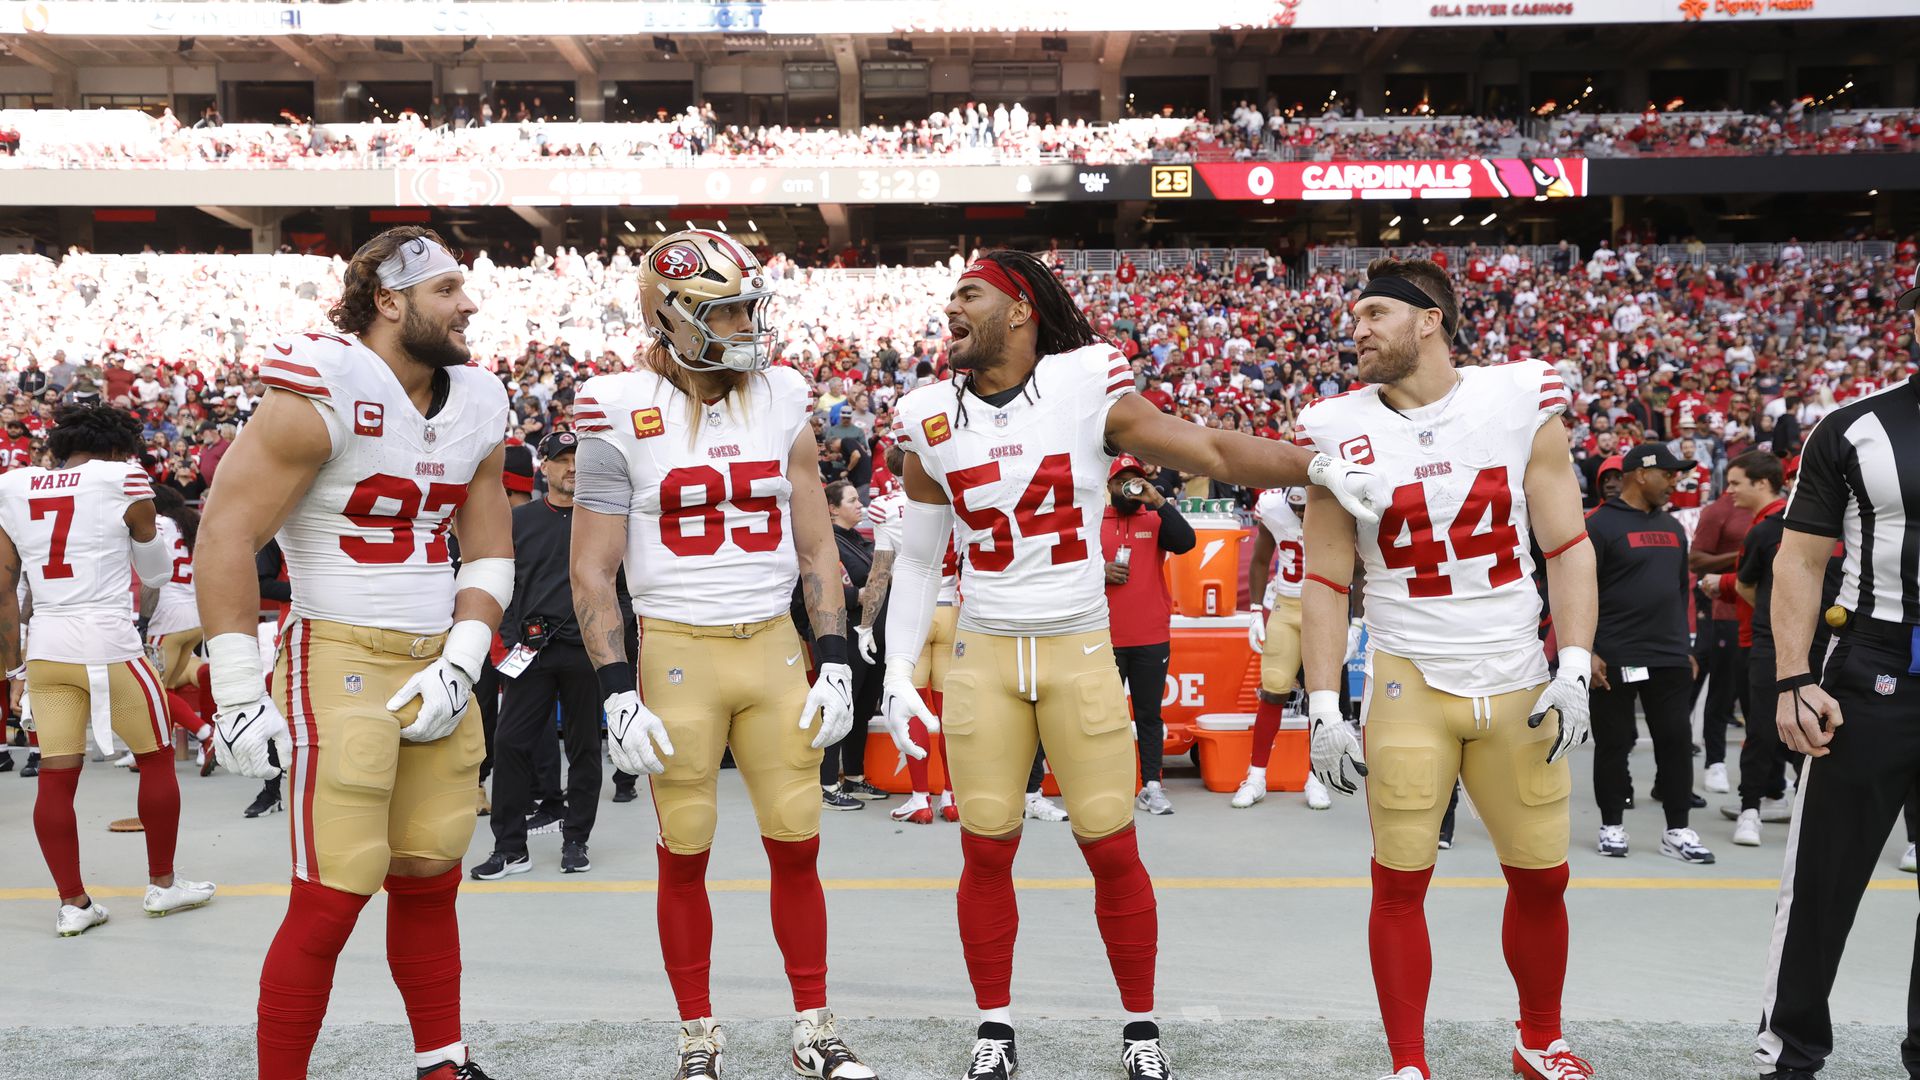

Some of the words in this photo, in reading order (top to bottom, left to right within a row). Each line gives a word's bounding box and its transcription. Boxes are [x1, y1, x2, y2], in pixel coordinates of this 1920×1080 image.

[1430, 5, 1461, 17] GILA
[1466, 4, 1507, 16] RIVER
[1512, 3, 1573, 15] CASINOS
[705, 171, 731, 199] 0
[819, 171, 830, 198] 1
[857, 169, 940, 199] 3:29
[1079, 172, 1109, 184] BALL
[1085, 182, 1104, 192] ON
[1156, 171, 1188, 191] 25
[1247, 166, 1274, 195] 0
[1302, 164, 1471, 189] CARDINALS
[356, 403, 383, 427] C
[635, 409, 661, 430] C
[924, 413, 947, 436] C
[708, 444, 741, 459] 49ERS
[989, 443, 1024, 460] 49ERS
[415, 461, 445, 477] 49ERS
[1414, 461, 1453, 480] 49ERS
[30, 472, 81, 491] WARD
[339, 472, 469, 564] 97
[659, 460, 783, 557] 85
[945, 452, 1088, 572] 54
[28, 495, 75, 580] 7
[1377, 465, 1524, 598] 44
[1640, 532, 1672, 545] 49ERS
